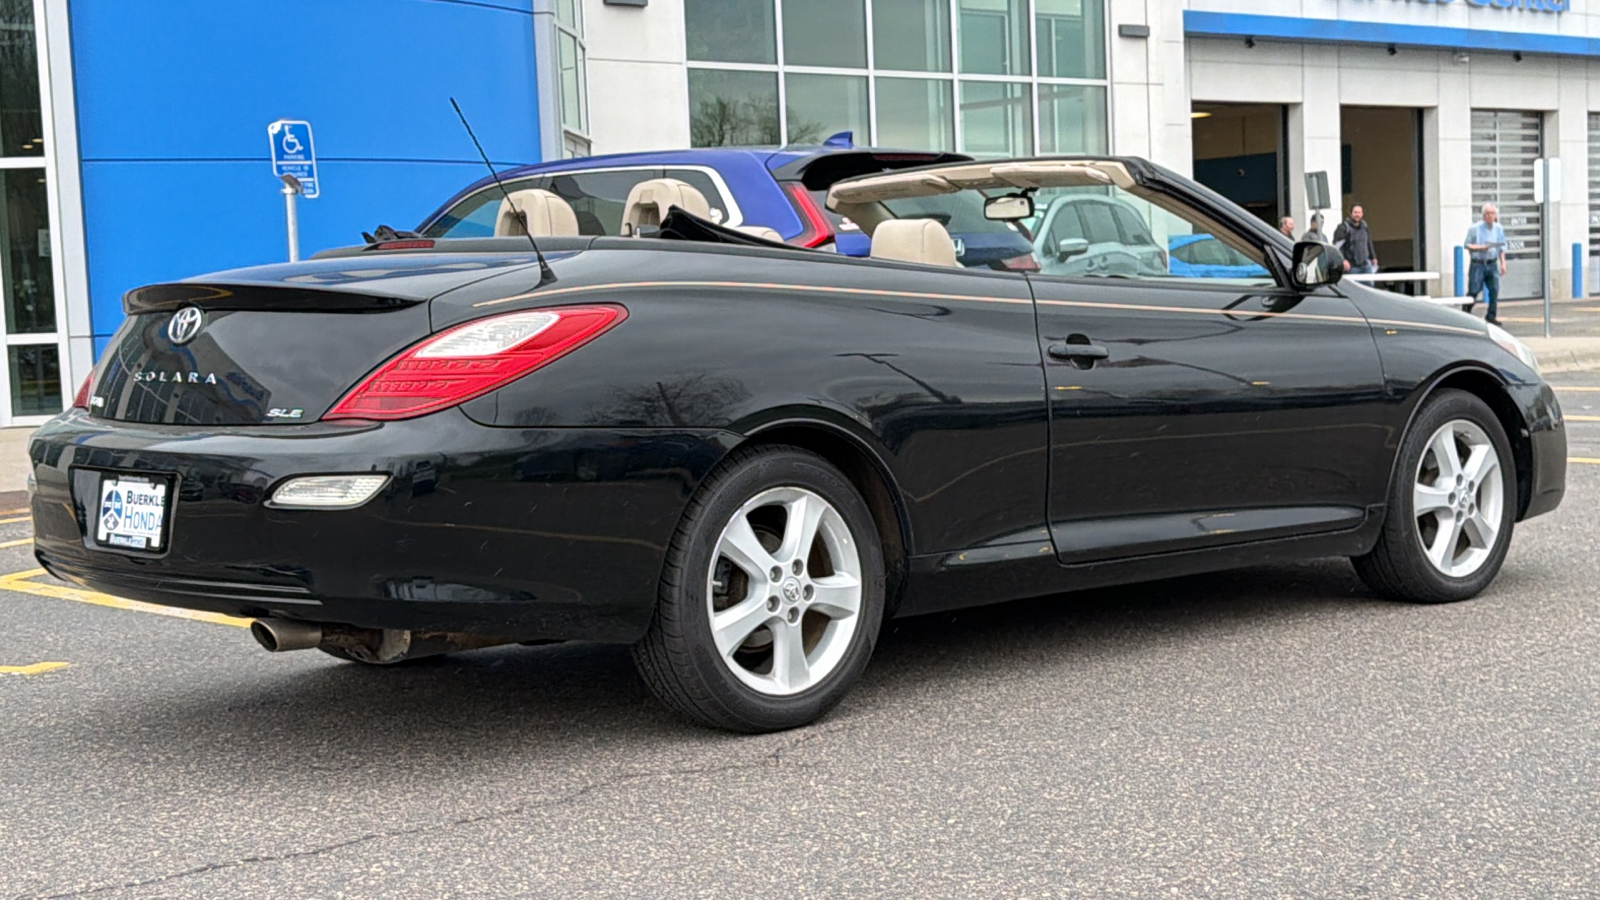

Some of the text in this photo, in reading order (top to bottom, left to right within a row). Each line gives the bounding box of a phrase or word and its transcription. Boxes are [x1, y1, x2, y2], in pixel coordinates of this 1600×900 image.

[132, 371, 217, 385] SOLARA
[265, 407, 304, 418] SLE
[126, 490, 165, 507] BUERKLE
[123, 506, 163, 531] HONDA
